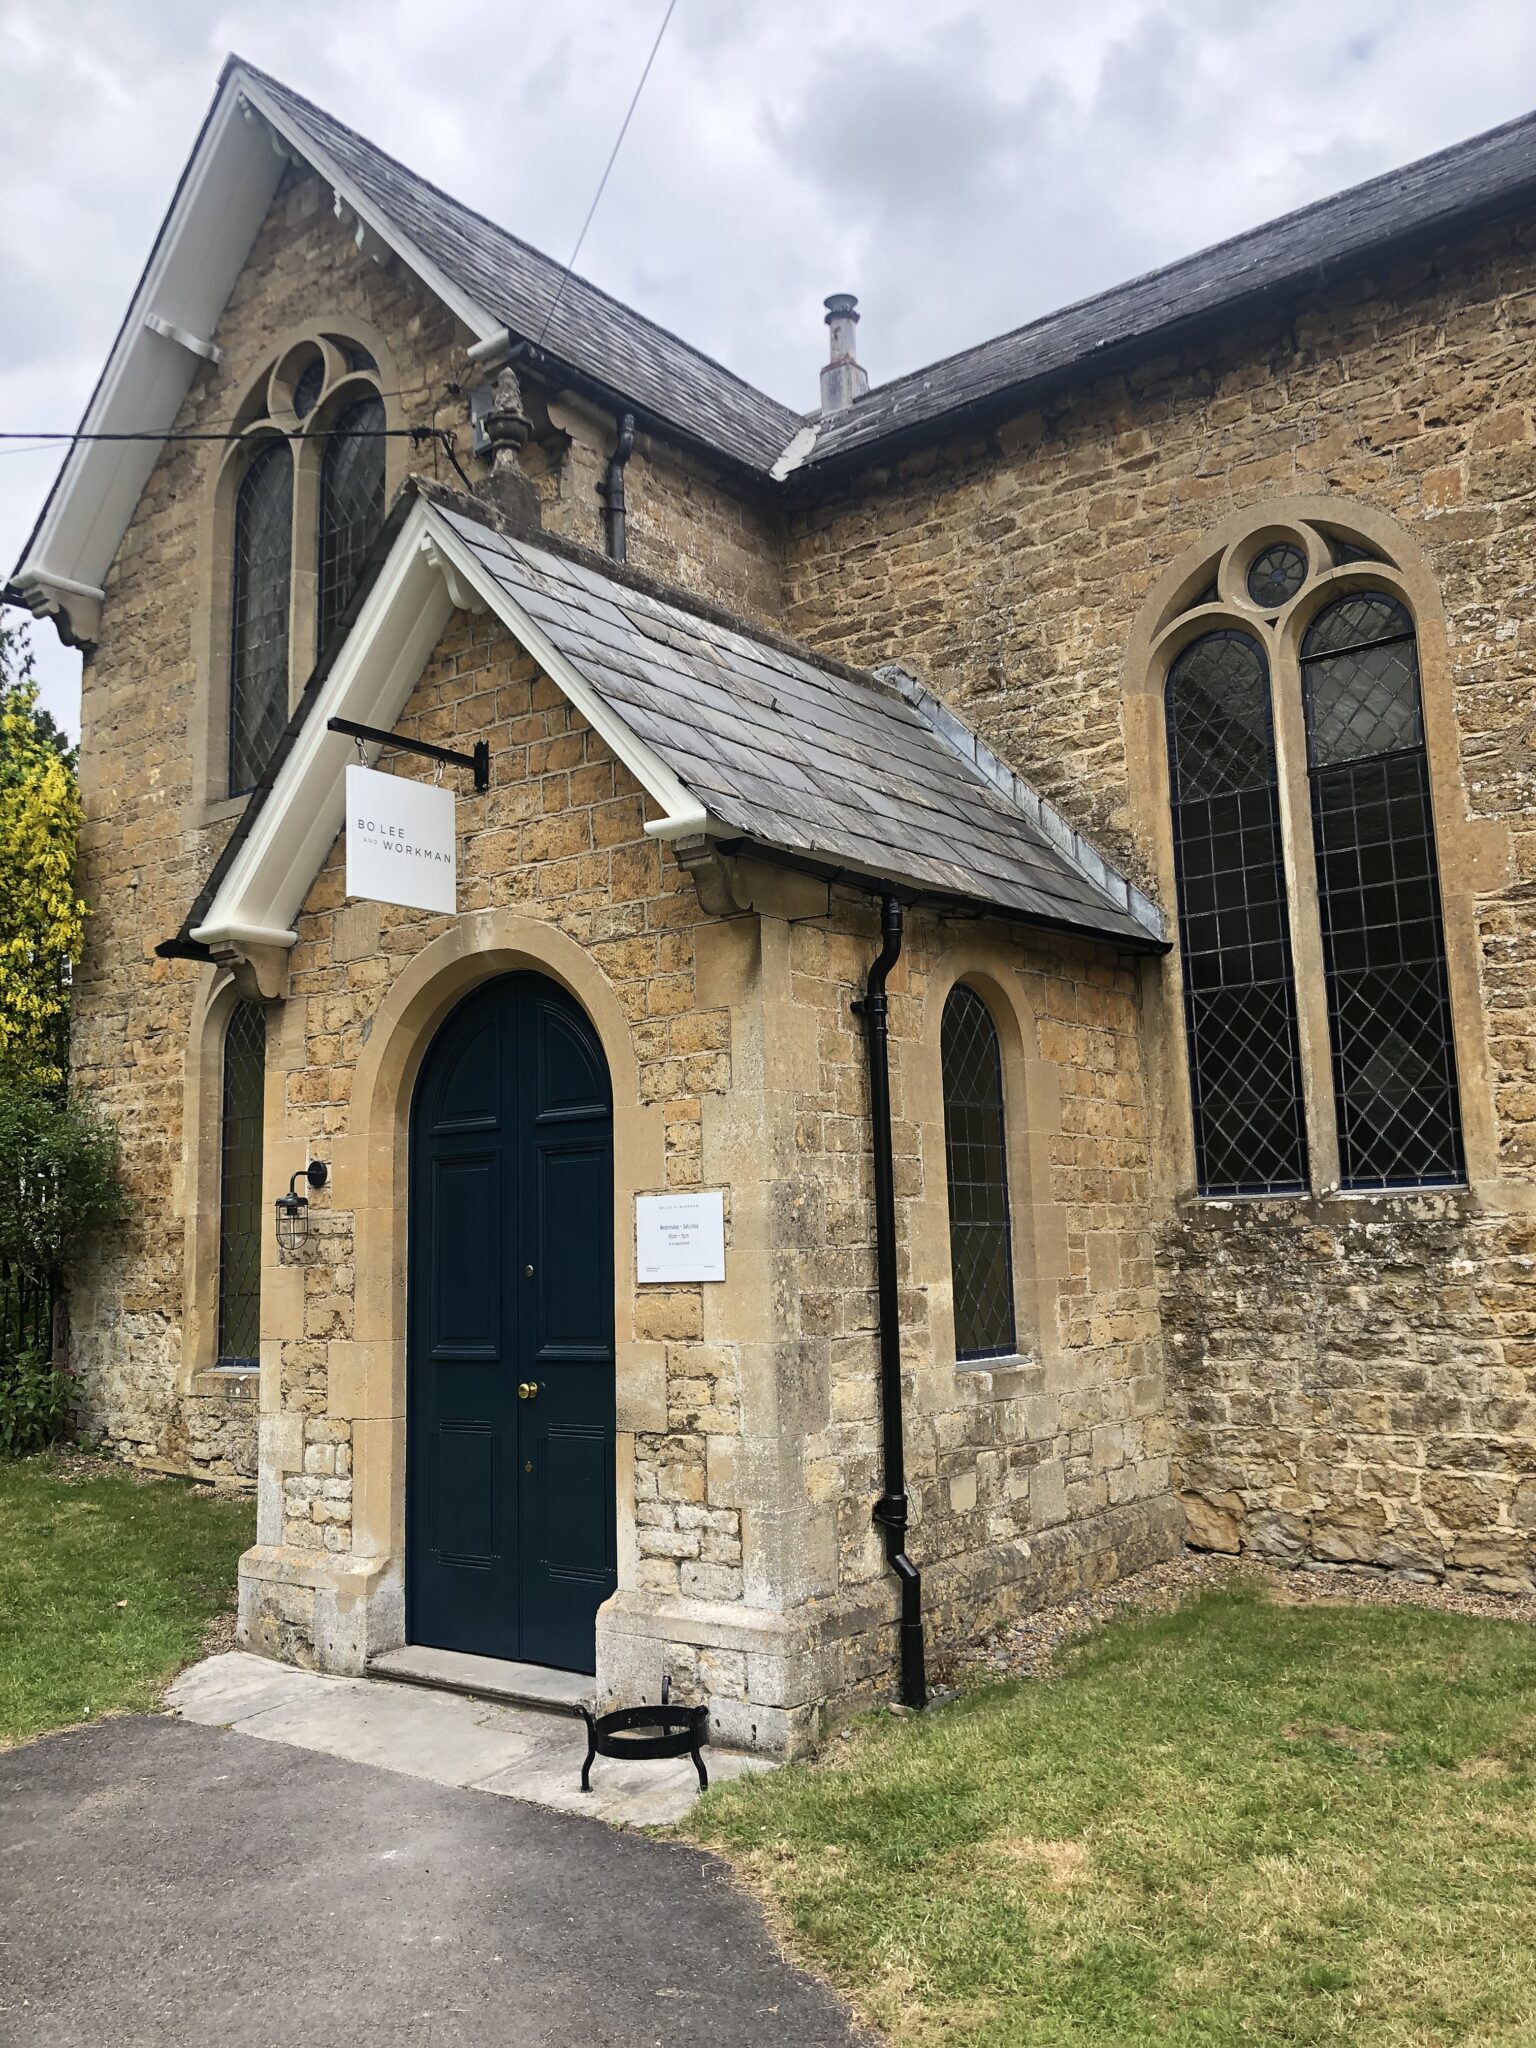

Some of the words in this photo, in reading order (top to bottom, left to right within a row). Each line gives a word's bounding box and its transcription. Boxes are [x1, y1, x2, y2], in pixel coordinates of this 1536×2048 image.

[358, 819, 375, 831] BO
[380, 824, 405, 838] LEE
[363, 837, 378, 845] AND
[383, 840, 451, 863] WORKMAN
